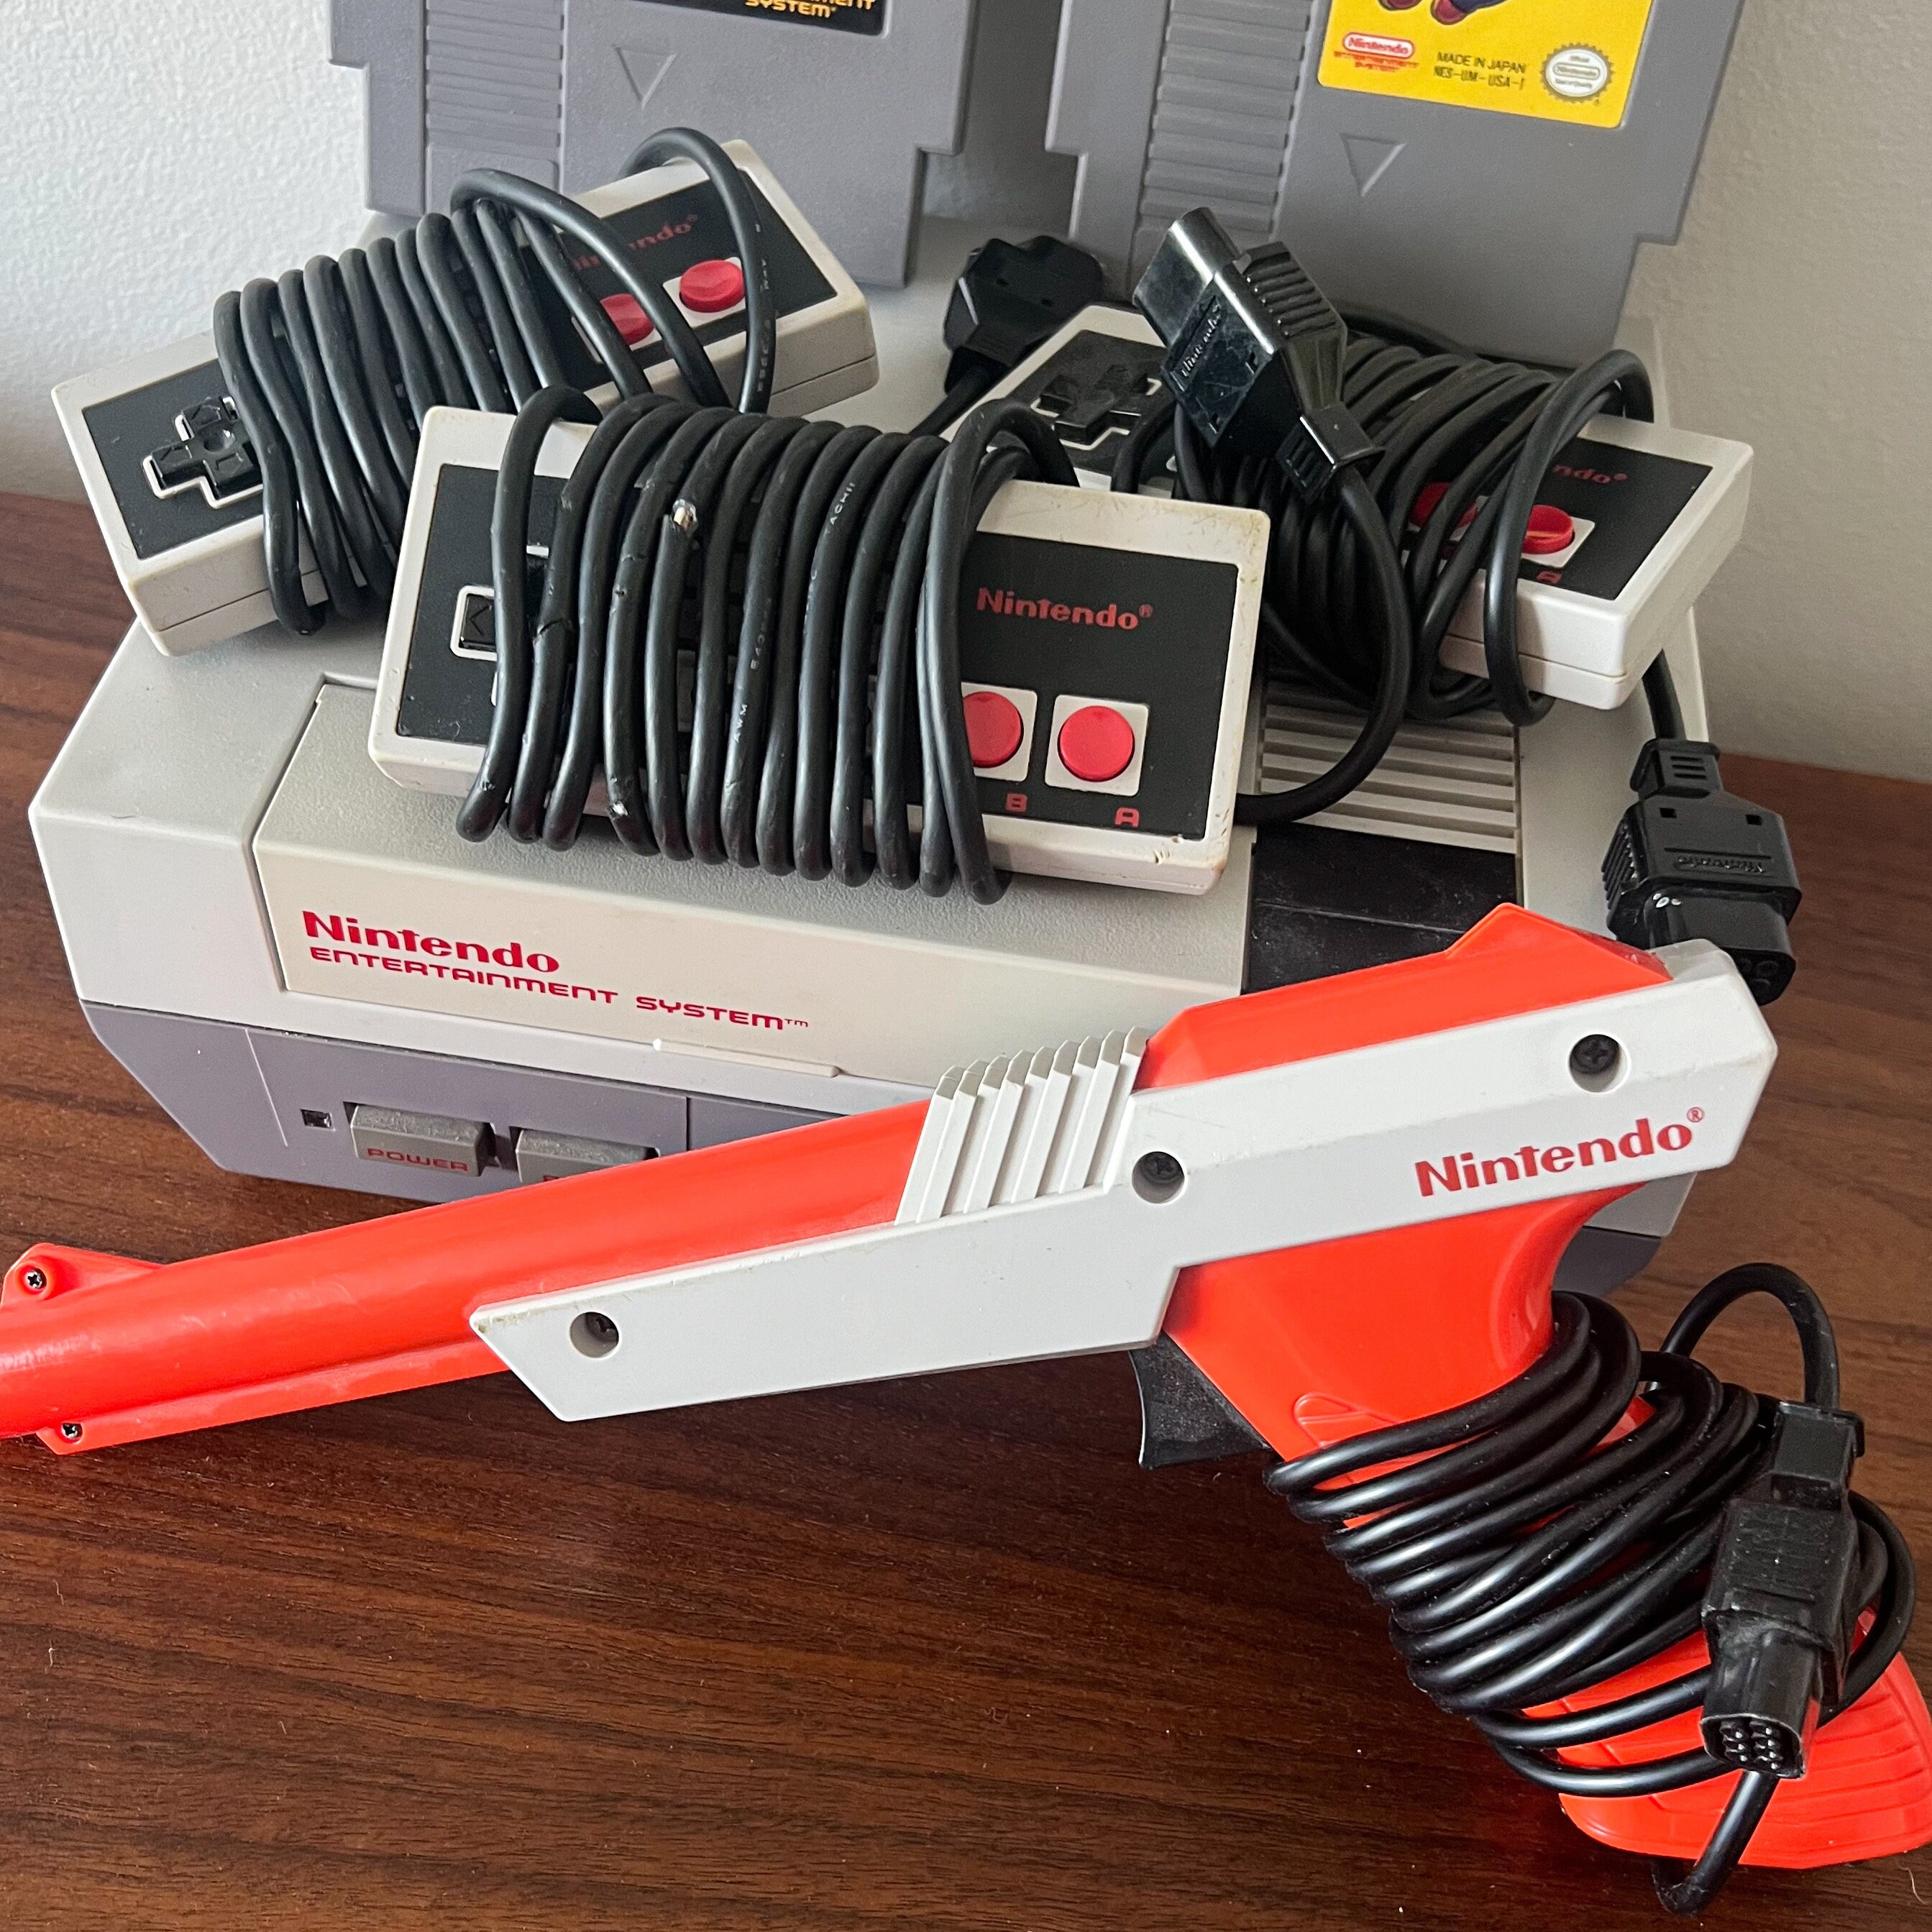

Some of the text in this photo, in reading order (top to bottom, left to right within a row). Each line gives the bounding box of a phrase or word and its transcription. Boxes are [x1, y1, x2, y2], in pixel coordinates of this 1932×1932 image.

[1437, 51, 1526, 73] MADE IN JAPAN
[1006, 793, 1027, 812] B
[1114, 807, 1140, 828] A
[302, 910, 560, 974] Nintendo
[309, 946, 618, 1004] ENTERTAINMENT
[367, 1147, 469, 1173] POWER
